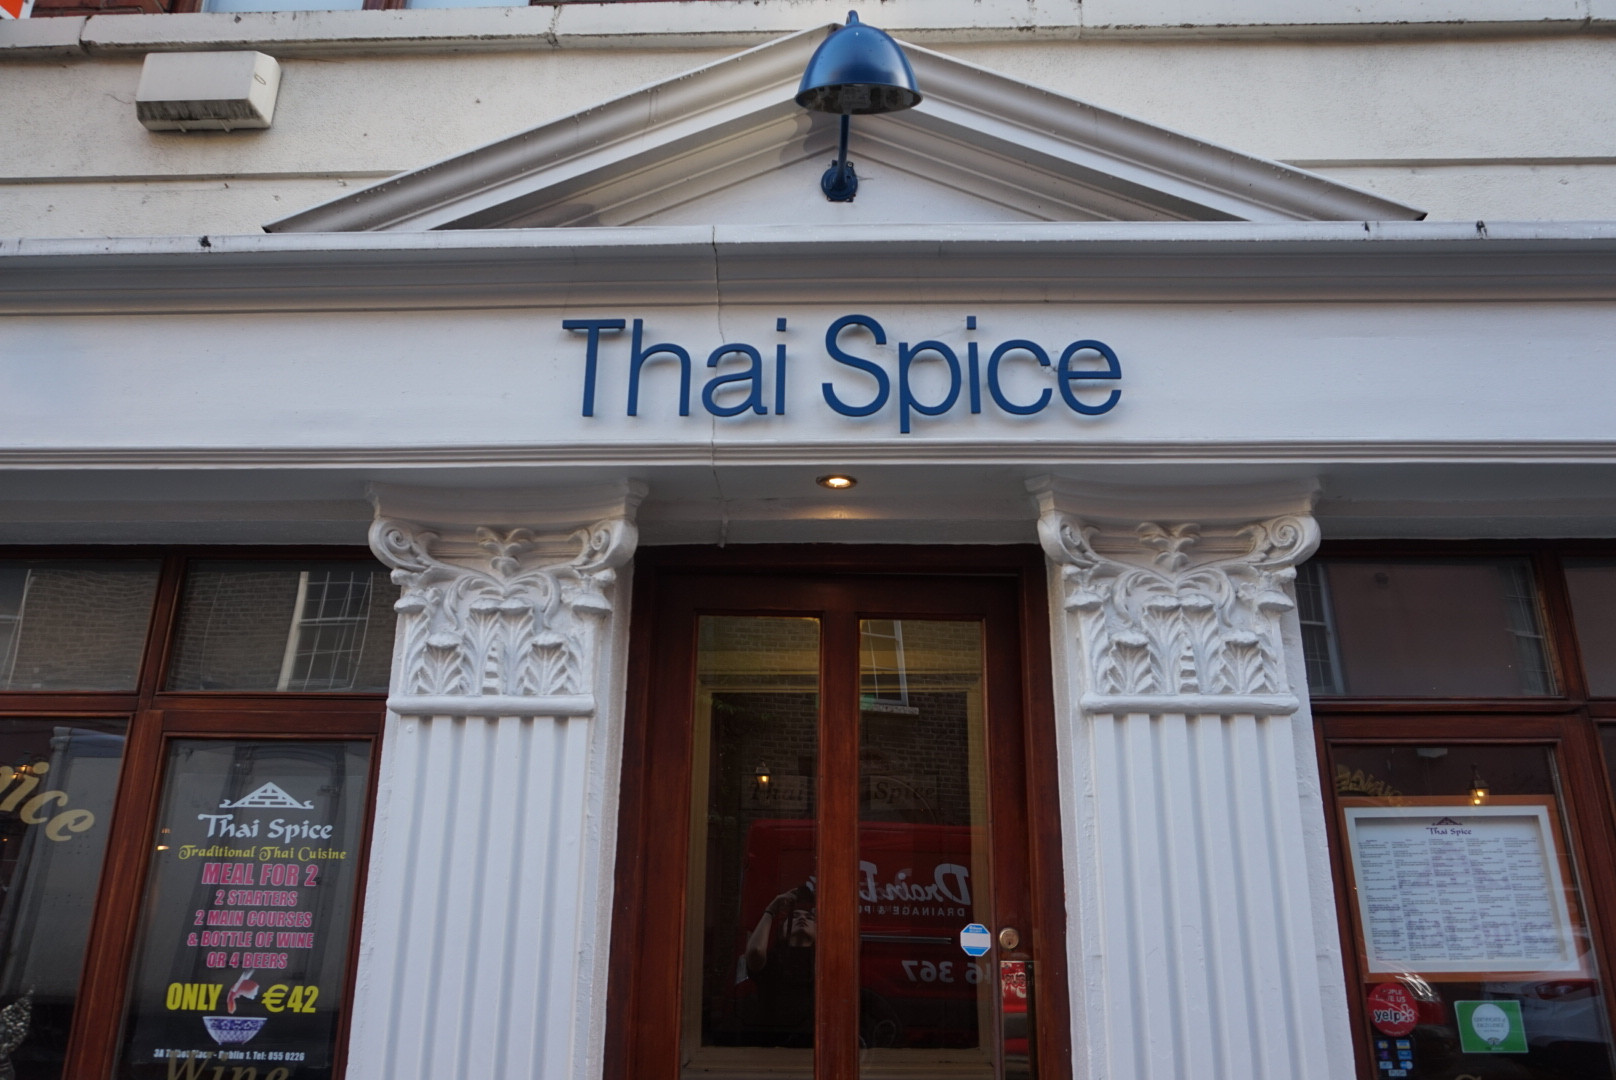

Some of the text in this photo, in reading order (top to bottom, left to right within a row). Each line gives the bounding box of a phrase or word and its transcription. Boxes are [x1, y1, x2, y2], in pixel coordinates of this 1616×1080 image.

[562, 313, 1122, 434] Thai Spice
[0, 761, 95, 842] ice
[198, 813, 333, 844] Thai Spice
[1425, 826, 1473, 836] Thai Spice
[178, 844, 347, 862] Traditional Thai Cuisine
[201, 862, 319, 887] MEAL FOR 2
[215, 890, 298, 907] 2 STARTERS
[194, 910, 313, 928] 2 MAIN COURSES
[186, 931, 315, 949] & BOTTLE OF WINE
[206, 952, 288, 969] OR 4 BEERS
[165, 982, 320, 1013] ONLY €42
[1373, 1008, 1402, 1024] yelp
[253, 1051, 267, 1061] Tel:
